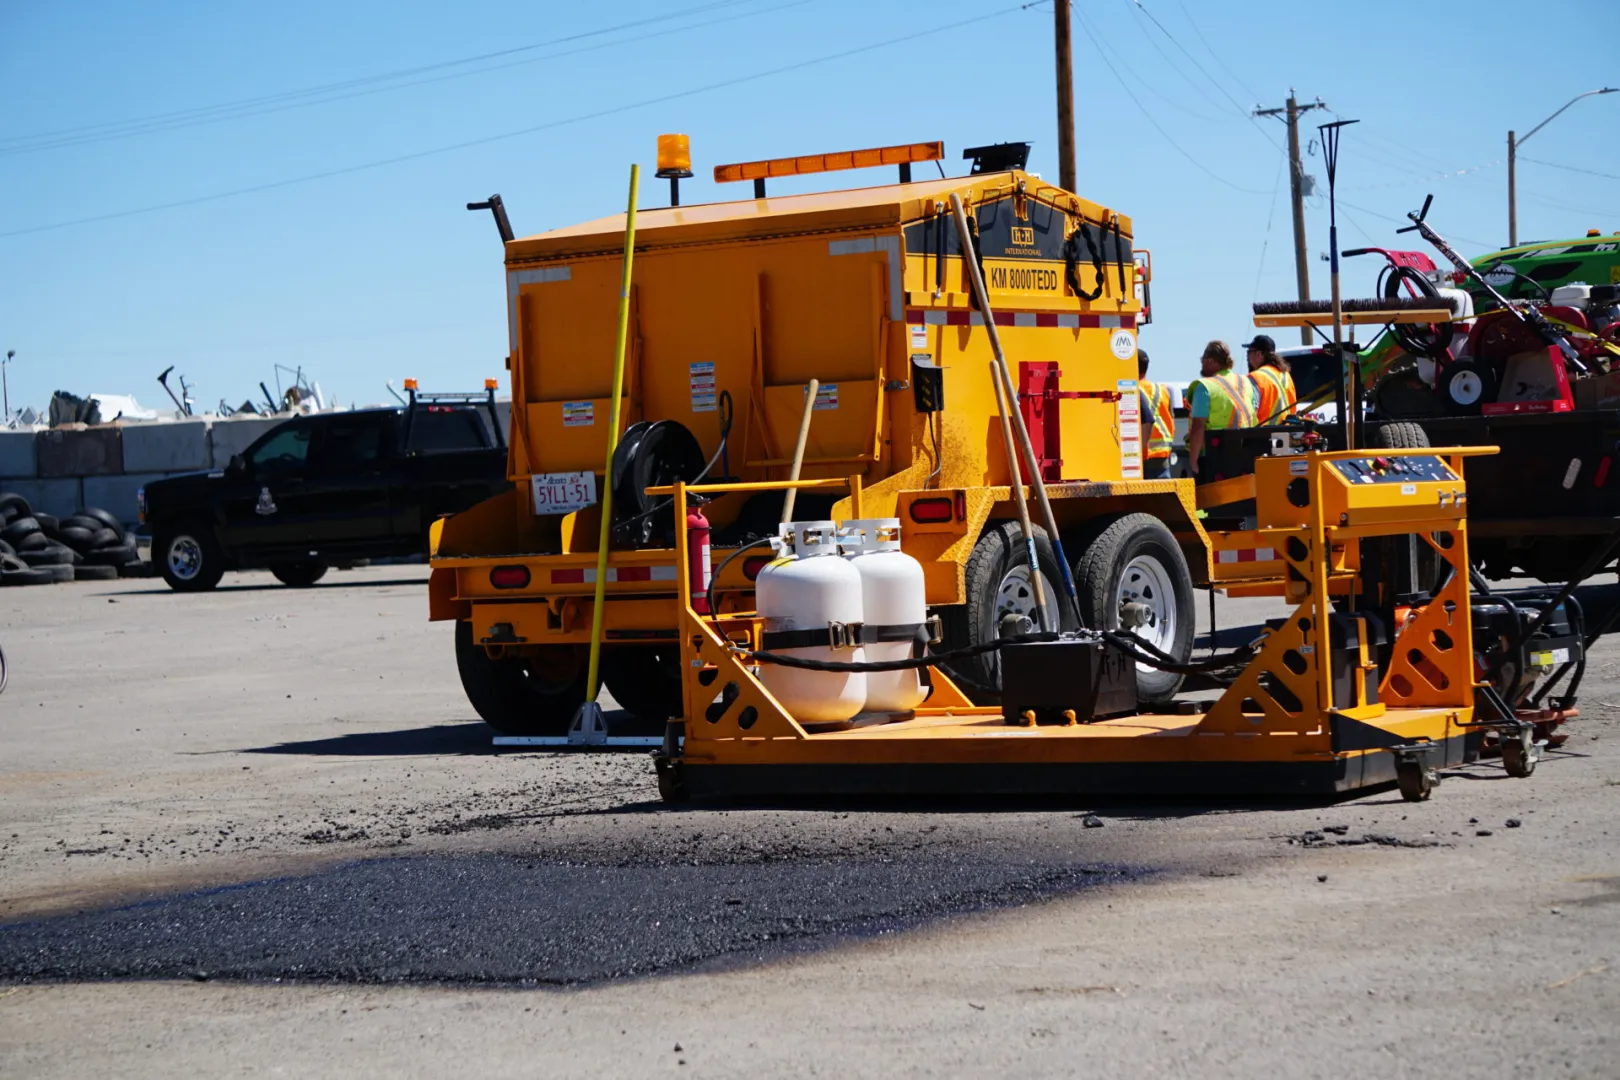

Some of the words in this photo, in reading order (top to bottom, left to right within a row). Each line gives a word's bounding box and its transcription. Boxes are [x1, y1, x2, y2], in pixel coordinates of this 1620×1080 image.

[1004, 247, 1042, 256] INTERNATIONAL
[991, 267, 1007, 289] KM
[1009, 268, 1058, 290] 8000TEDD
[539, 484, 591, 504] 5YL1-51
